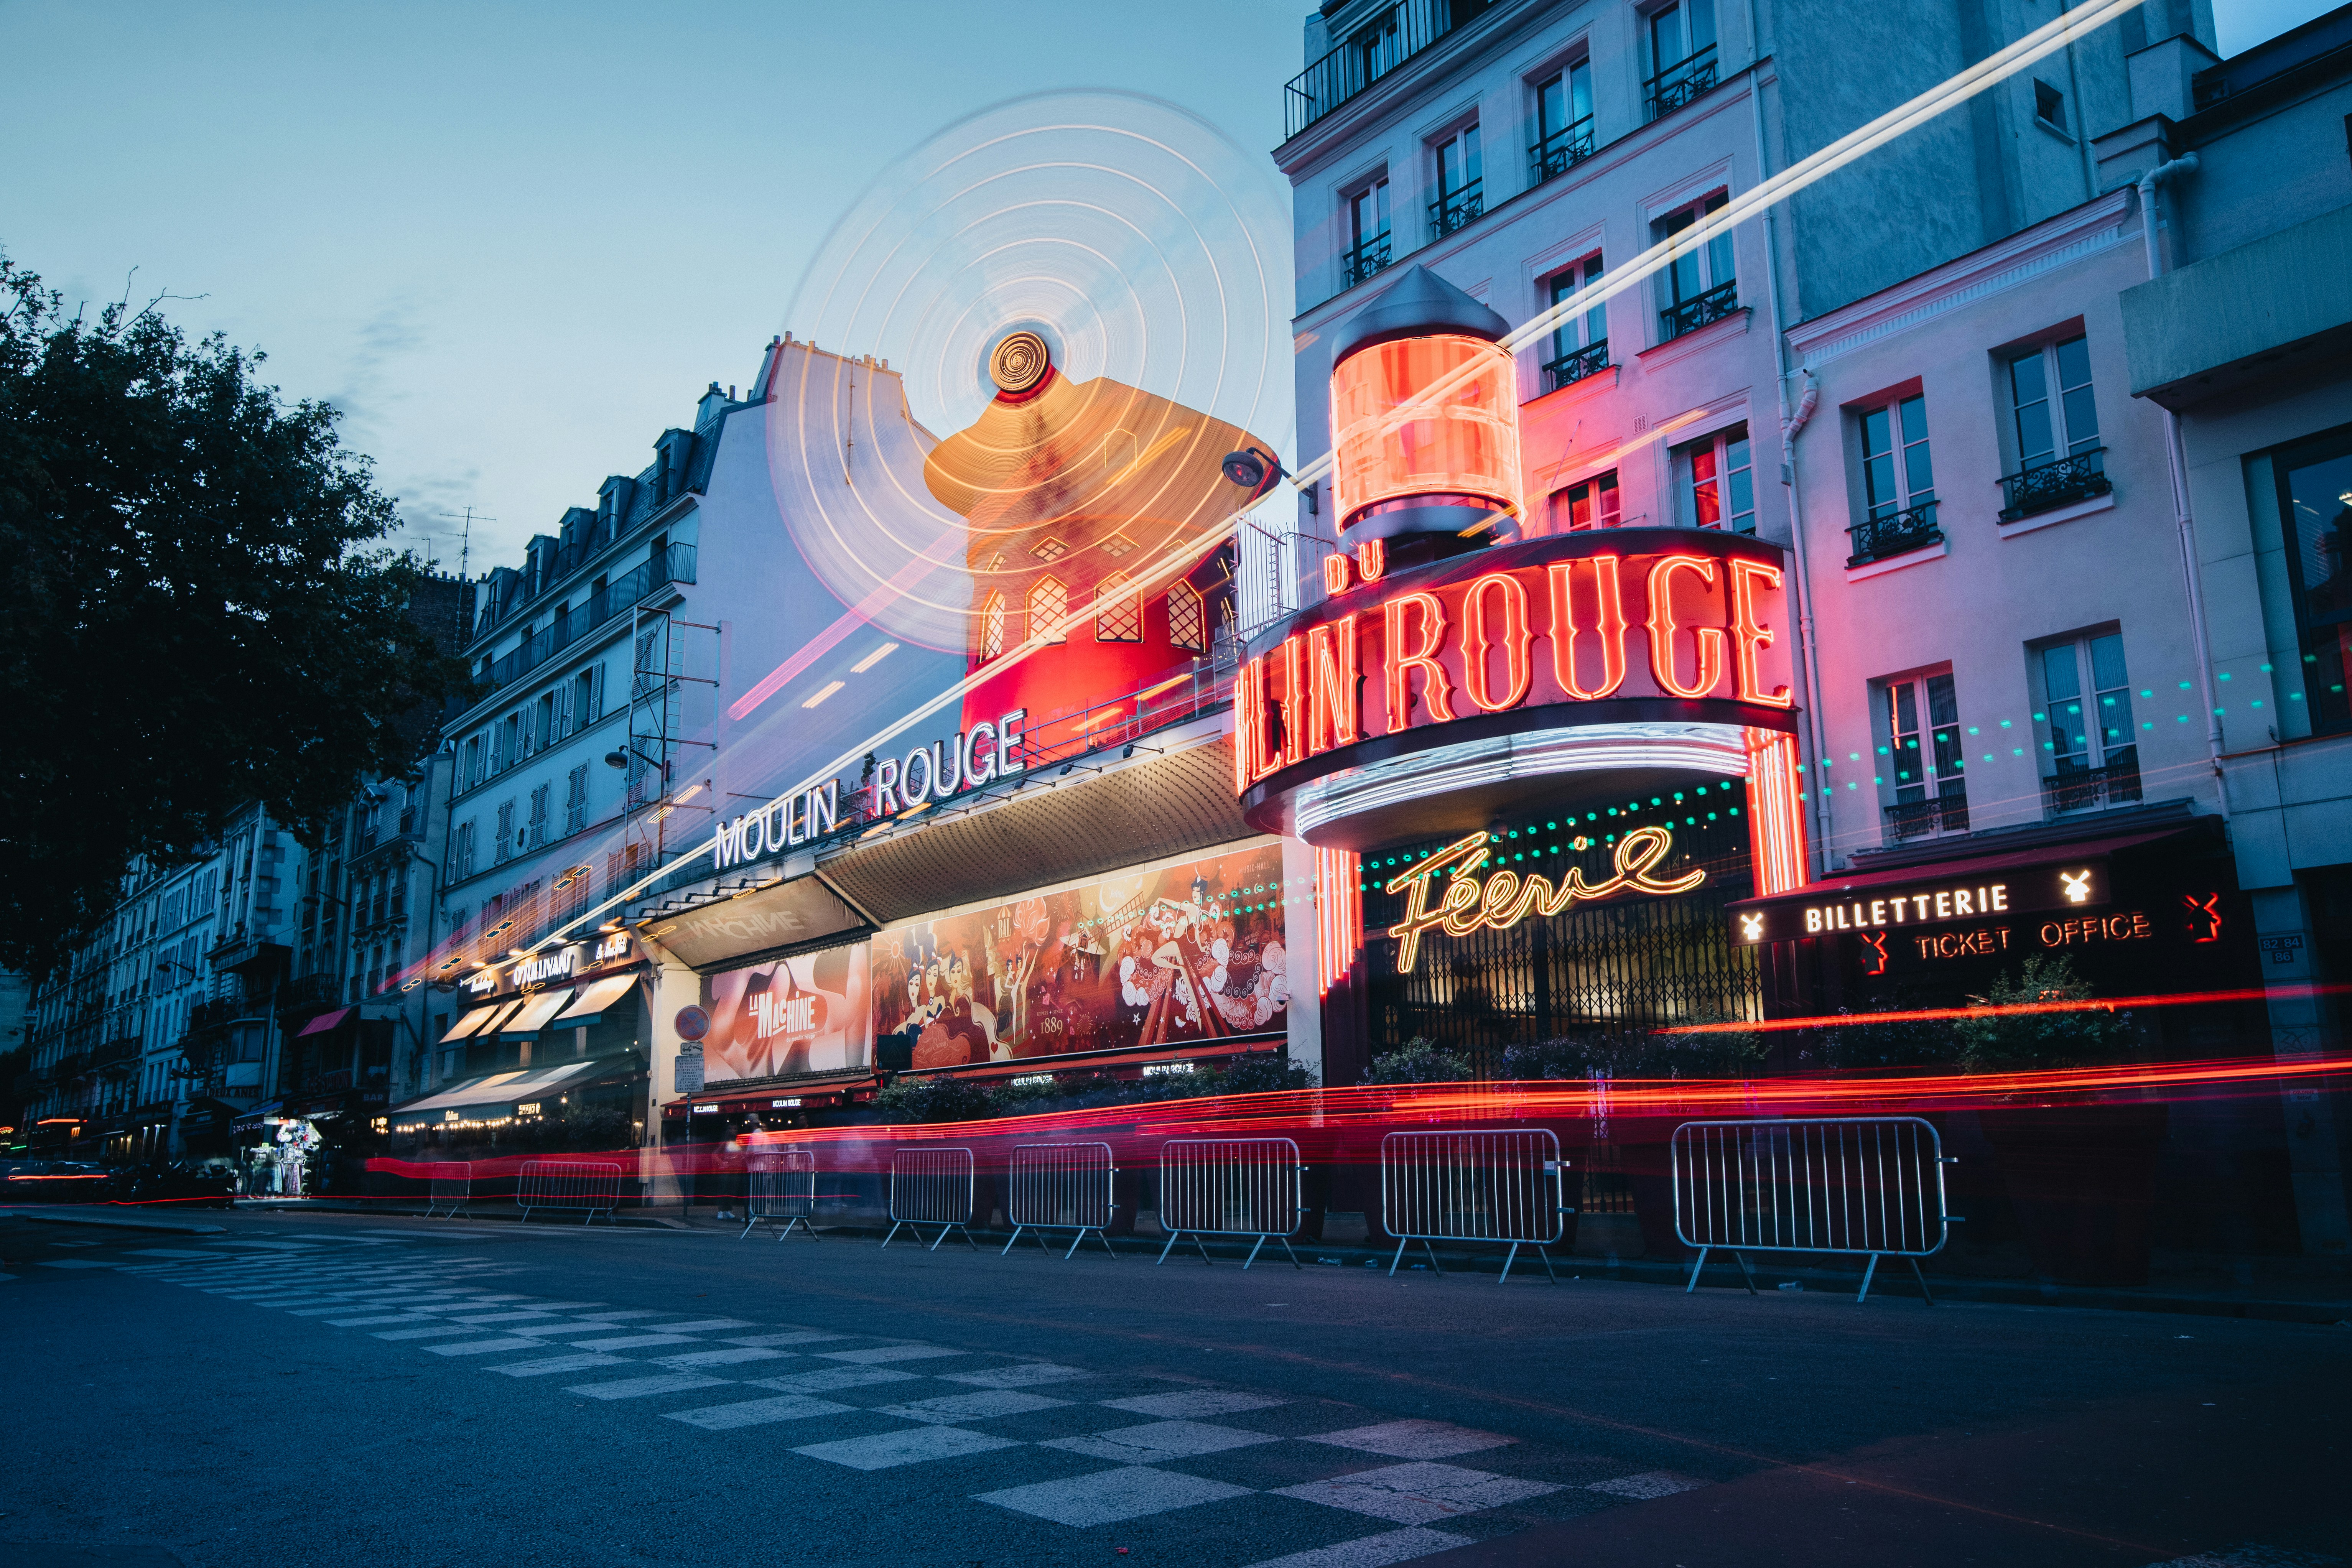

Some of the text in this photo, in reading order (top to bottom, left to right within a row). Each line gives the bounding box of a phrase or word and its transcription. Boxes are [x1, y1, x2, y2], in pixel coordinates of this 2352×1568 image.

[1324, 539, 1384, 595] DU
[1384, 554, 1791, 734] ROUGE
[715, 709, 1027, 870] MOULIN ROUGE
[1386, 827, 1707, 974] Féerie
[1806, 884, 2008, 933] BILLETTERIE
[998, 918, 1011, 939] BAL
[1916, 912, 2152, 959] TICKET OFFICE
[2263, 938, 2299, 949] 82 84
[2275, 952, 2291, 961] 86
[749, 995, 758, 1011] LA
[1040, 1017, 1063, 1036] 1889
